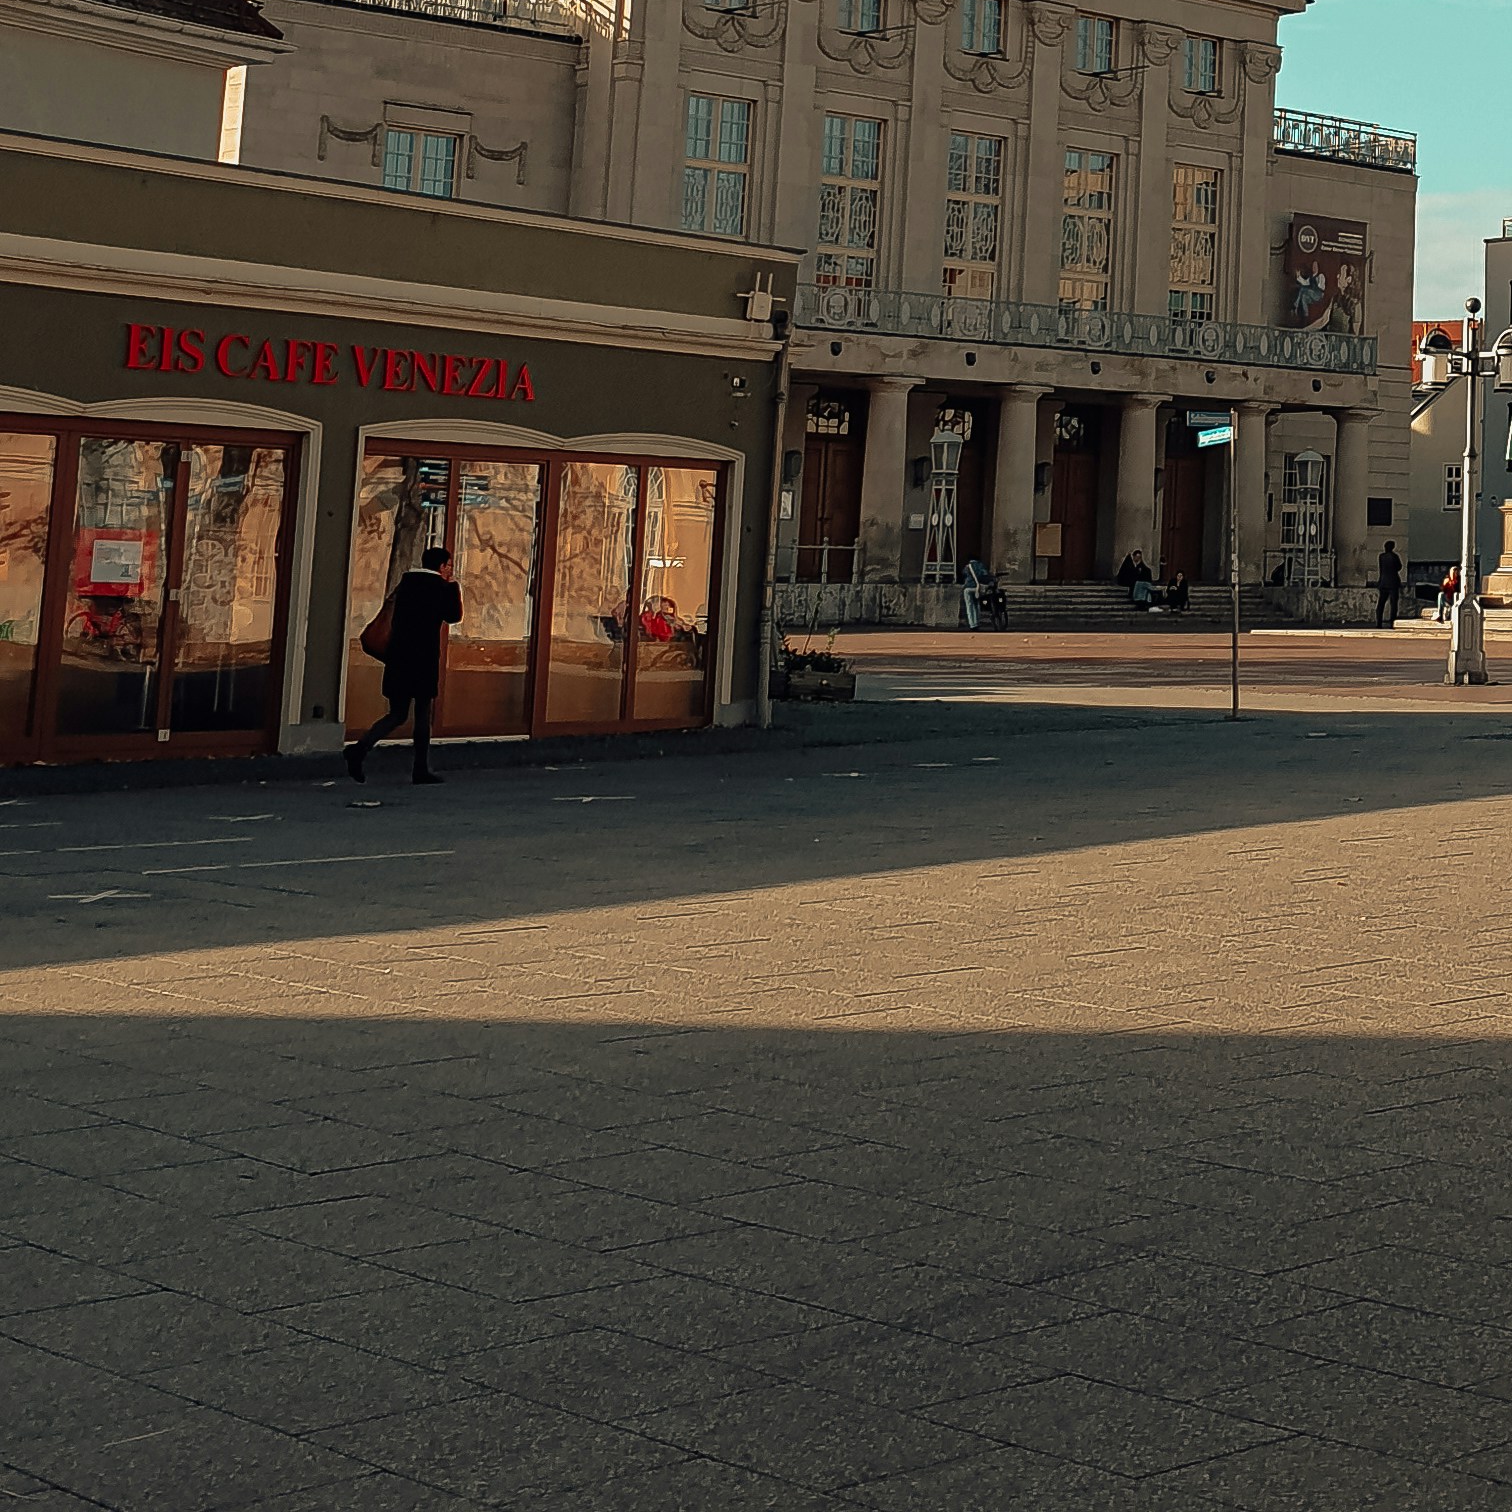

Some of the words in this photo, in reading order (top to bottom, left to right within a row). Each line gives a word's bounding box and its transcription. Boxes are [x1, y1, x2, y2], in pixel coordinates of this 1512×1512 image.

[126, 323, 205, 372] EIS
[215, 334, 338, 384] CAFE
[352, 345, 536, 401] VENEZIA
